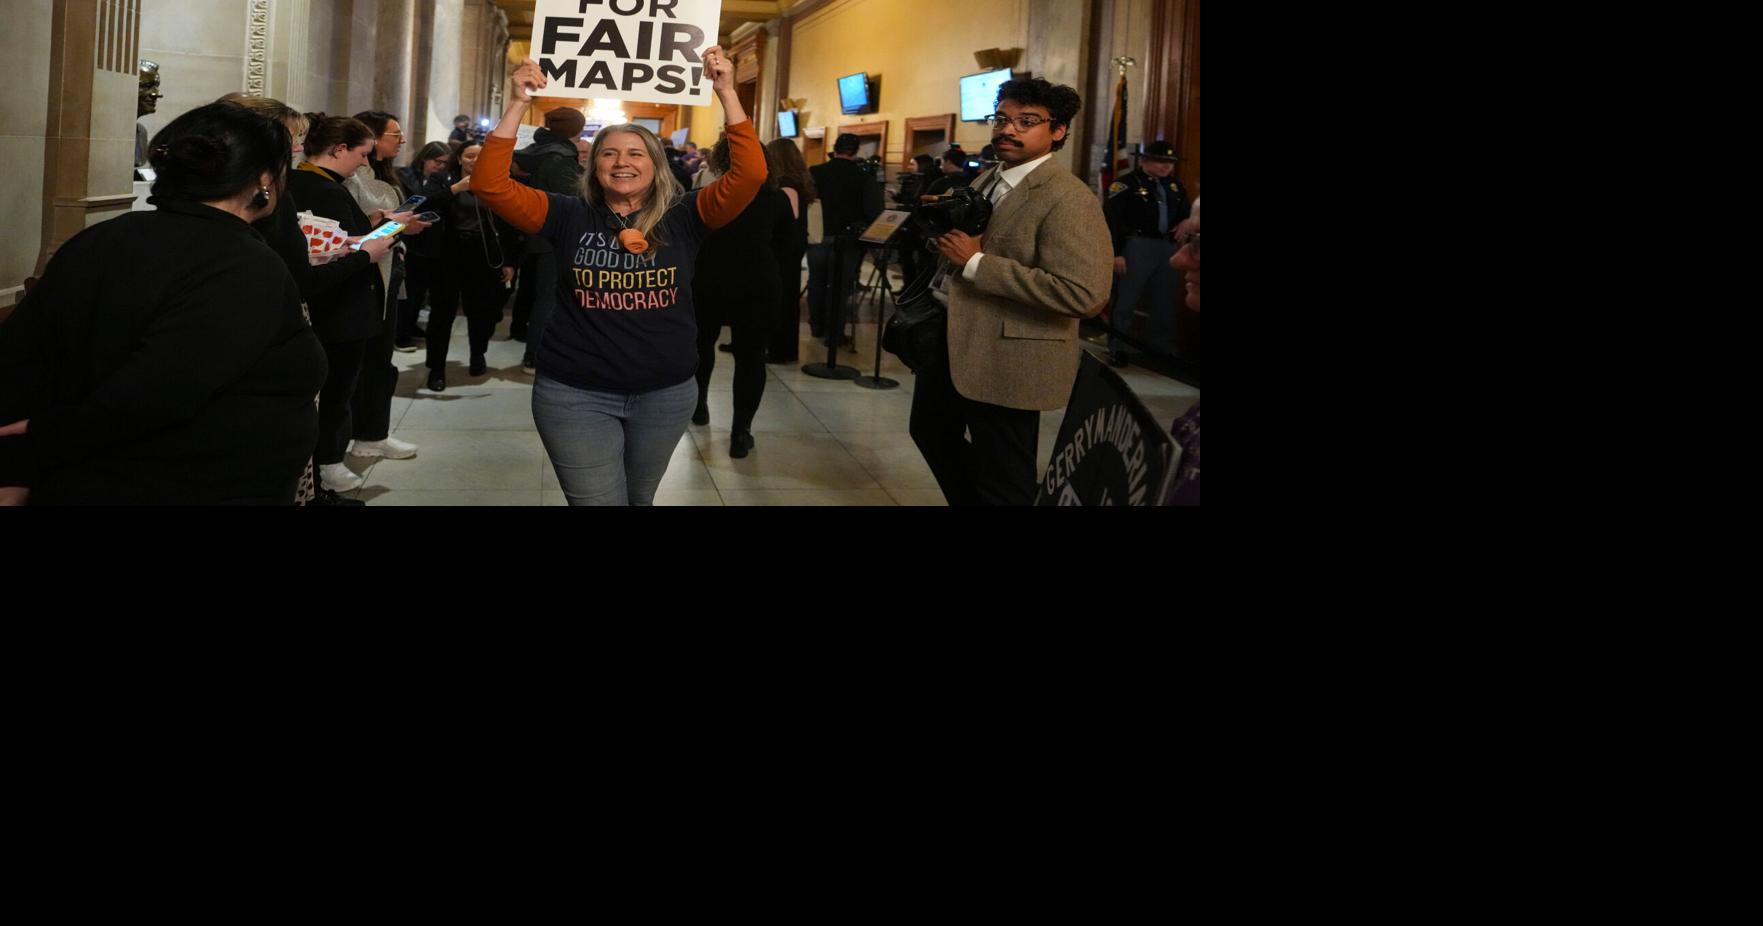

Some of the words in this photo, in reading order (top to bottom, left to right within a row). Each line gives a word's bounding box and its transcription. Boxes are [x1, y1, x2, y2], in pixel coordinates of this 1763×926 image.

[578, 0, 677, 19] FOR
[541, 16, 705, 63] FAIR
[538, 58, 704, 96] MAPS!
[574, 246, 619, 268] GOOD
[572, 267, 593, 288] TO
[598, 266, 677, 289] PROTECT
[574, 286, 679, 311] DEMOCRACY
